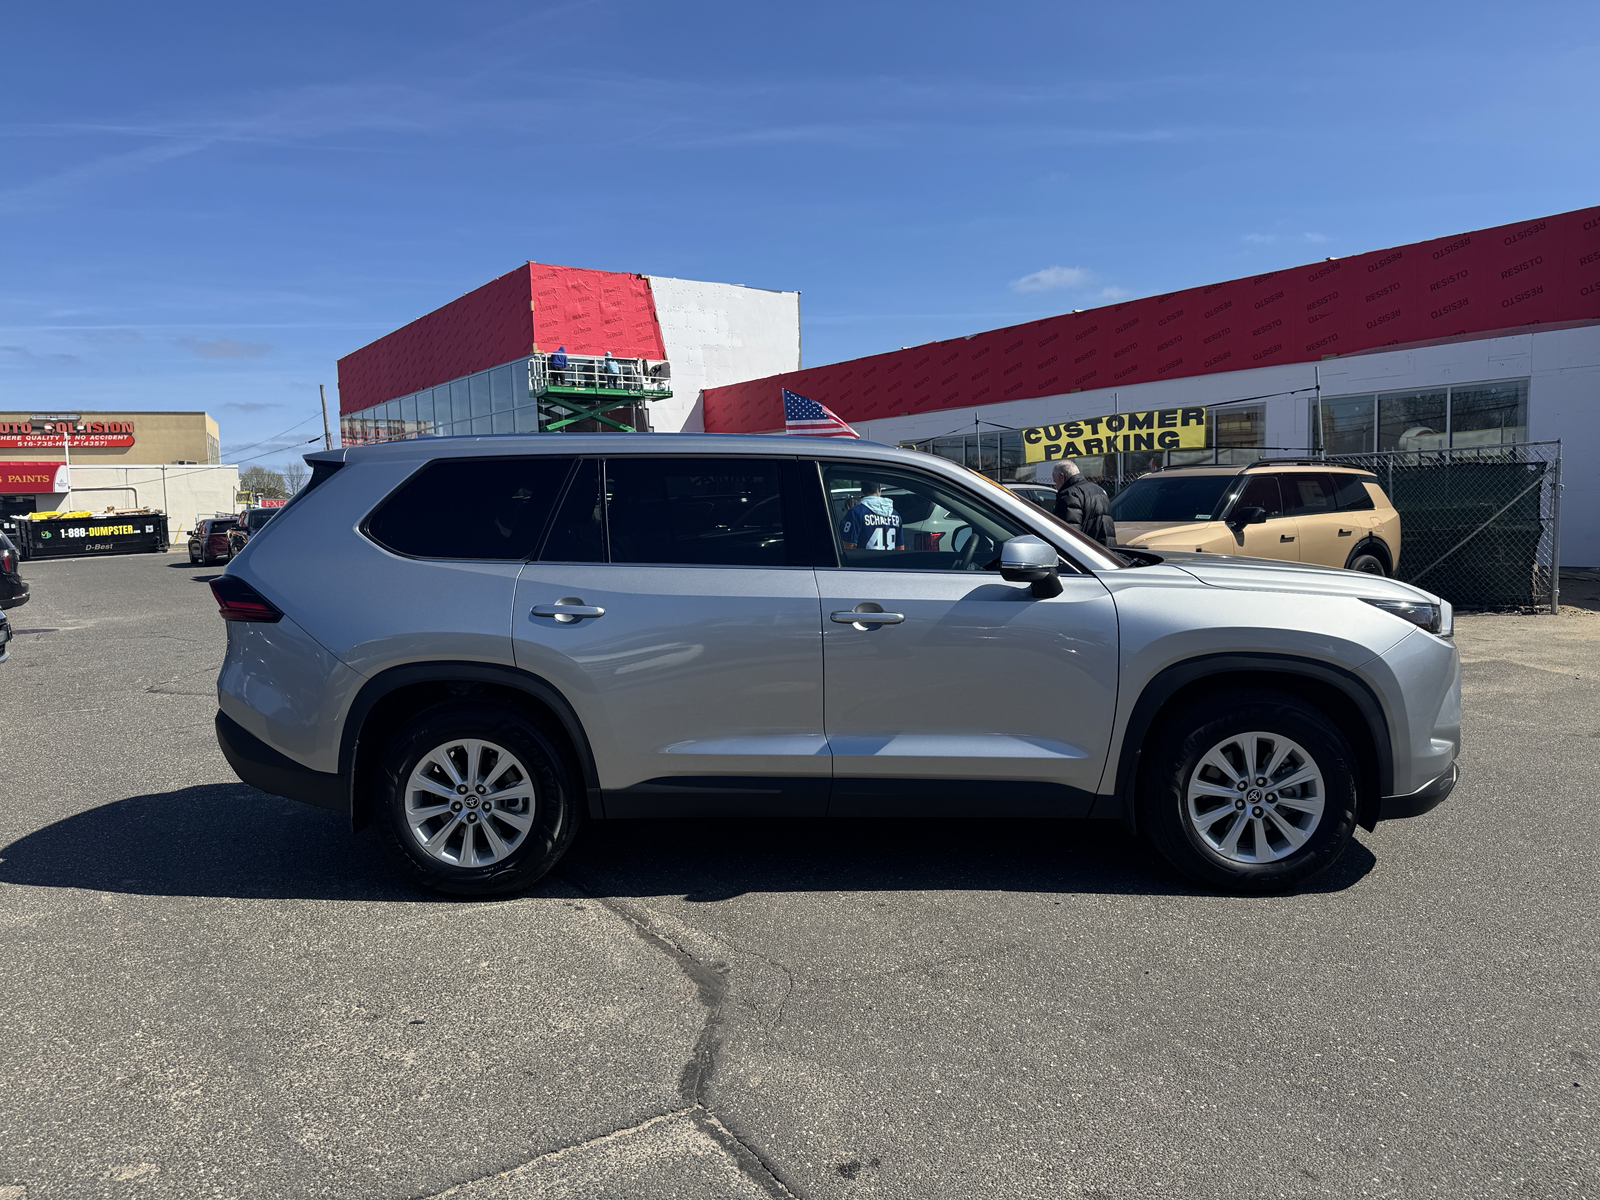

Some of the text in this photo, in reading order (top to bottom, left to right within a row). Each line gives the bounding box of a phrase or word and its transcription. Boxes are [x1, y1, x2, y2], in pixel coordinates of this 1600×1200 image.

[1504, 221, 1547, 246] RESISTO
[1432, 236, 1471, 260] RESISTO
[1367, 251, 1403, 273] RESISTO
[1501, 256, 1543, 279] RESISTO
[1308, 262, 1341, 282] RESISTO
[1429, 269, 1469, 292] RESISTO
[1254, 291, 1284, 310] RESISTO
[1307, 291, 1339, 311] RESISTO
[1366, 282, 1401, 303] RESISTO
[1501, 285, 1544, 308] RESISTO
[1205, 300, 1232, 319] RESISTO
[1430, 297, 1469, 319] RESISTO
[1115, 318, 1139, 334] RESISTO
[1158, 309, 1184, 326] RESISTO
[1366, 309, 1401, 329] RESISTO
[1075, 325, 1098, 341] RESISTO
[1203, 327, 1231, 345] RESISTO
[1252, 318, 1282, 337] RESISTO
[1004, 340, 1024, 354] RESISTO
[1039, 332, 1059, 347] RESISTO
[1157, 335, 1183, 352] RESISTO
[1306, 334, 1338, 352] RESISTO
[1074, 349, 1097, 364] RESISTO
[1114, 342, 1138, 358] RESISTO
[1253, 343, 1283, 361] RESISTO
[1037, 355, 1058, 370] RESISTO
[1157, 358, 1183, 374] RESISTO
[1204, 351, 1232, 368] RESISTO
[1003, 362, 1022, 376] RESISTO
[1075, 370, 1097, 385] RESISTO
[1114, 364, 1139, 380] RESISTO
[1004, 381, 1023, 396] RESISTO
[1038, 376, 1058, 390] RESISTO
[0, 421, 134, 434] UTO COLLISION
[1024, 407, 1206, 444] CUSTOMER
[1044, 430, 1180, 461] PARKING
[7, 474, 50, 483] PAINTS
[864, 514, 900, 527] SCHAEFER
[85, 543, 113, 551] D-Best
